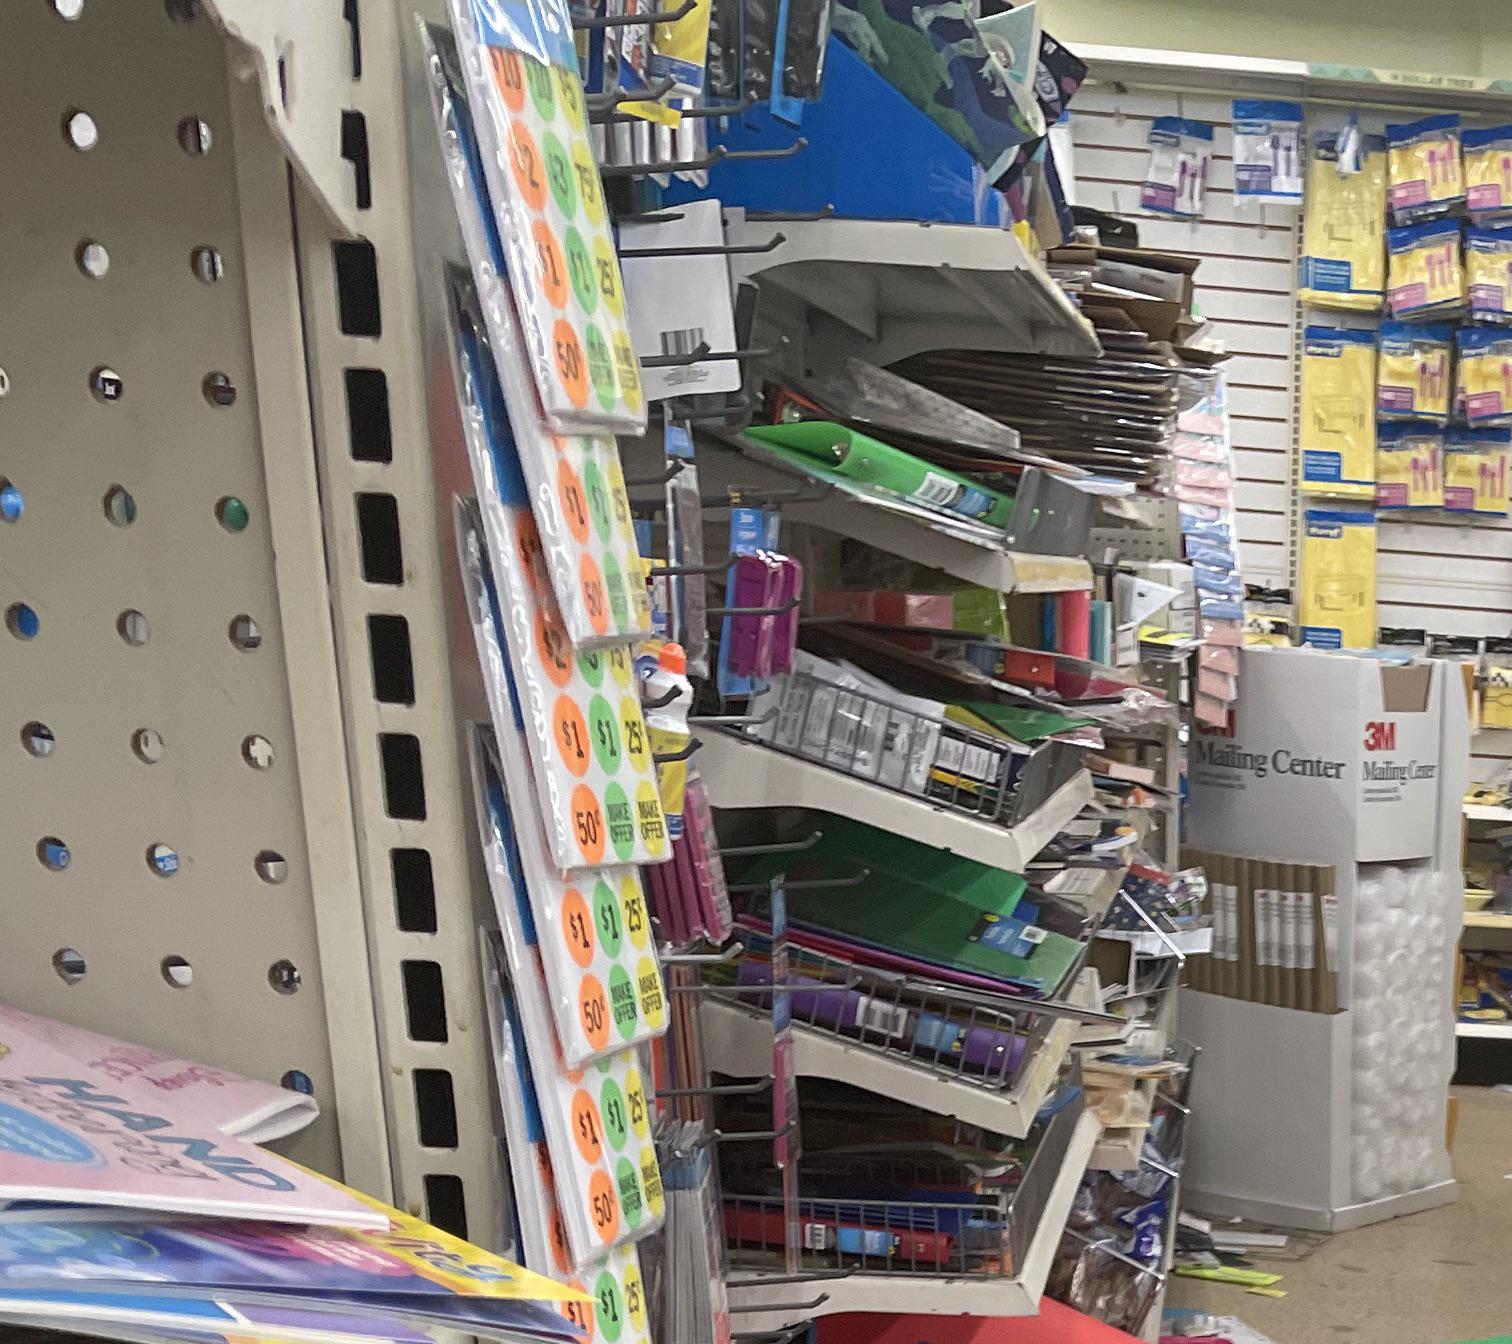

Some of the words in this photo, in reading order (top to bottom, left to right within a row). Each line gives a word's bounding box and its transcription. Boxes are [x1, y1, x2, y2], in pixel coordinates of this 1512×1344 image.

[562, 720, 584, 759] $1
[597, 719, 617, 757] $1
[1363, 722, 1396, 751] 3M
[1271, 750, 1347, 780] Center
[1362, 760, 1408, 785] Mailing
[569, 911, 590, 949] $1
[601, 904, 619, 940] $1
[24, 1075, 298, 1192] HAND
[602, 1289, 619, 1322] $1
